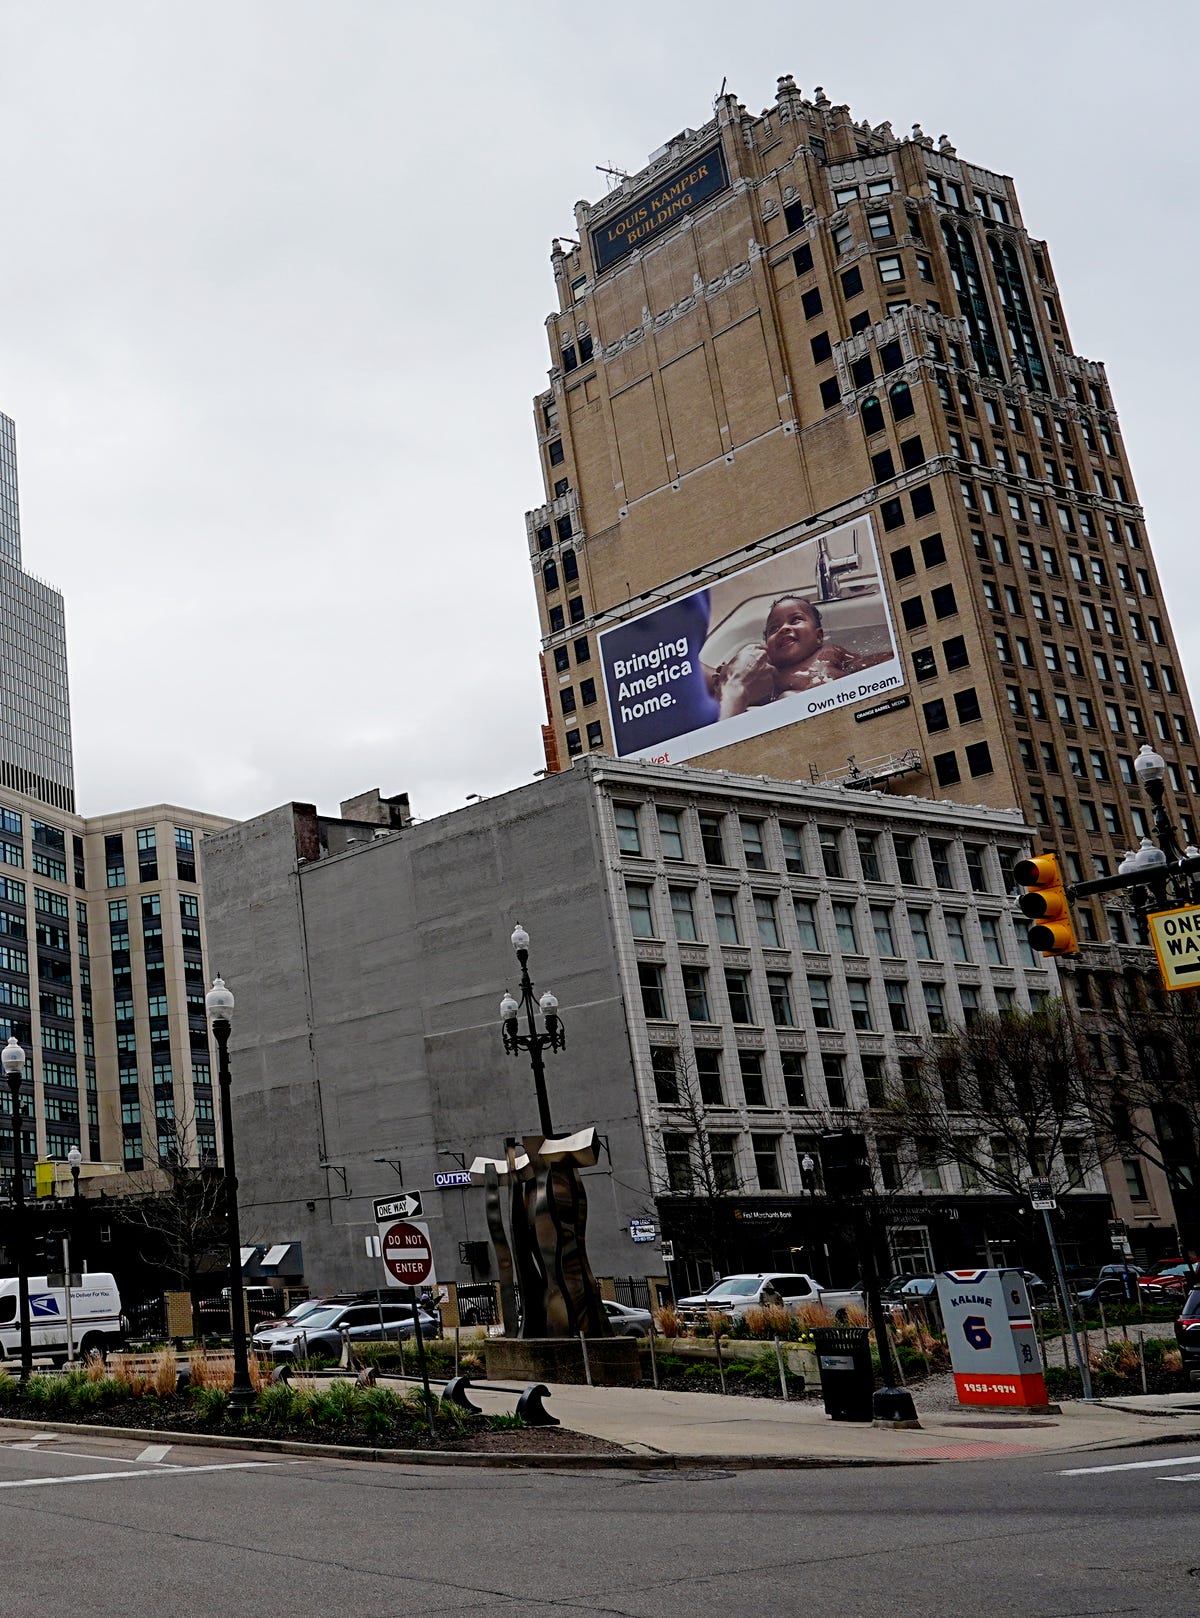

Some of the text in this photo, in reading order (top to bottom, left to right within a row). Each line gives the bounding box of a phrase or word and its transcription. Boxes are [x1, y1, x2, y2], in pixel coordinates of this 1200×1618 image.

[607, 164, 709, 242] LOUIS KAMPER
[627, 193, 693, 244] BUILDING
[613, 636, 689, 680] Bringing
[617, 659, 693, 702] America
[807, 675, 901, 713] Own the Dream.
[620, 691, 677, 723] home.
[856, 699, 906, 719] ORANGE BARREL MEDIA
[1164, 914, 1200, 936] ONE
[1167, 935, 1200, 956] WA
[378, 1201, 407, 1216] ONE WAY
[742, 1211, 793, 1219] First Merchants Bank
[388, 1234, 423, 1245] DO NOT
[395, 1262, 424, 1273] ENTER
[950, 1294, 993, 1308] KALINE
[1010, 1289, 1021, 1305] 6
[962, 1315, 992, 1351] 6
